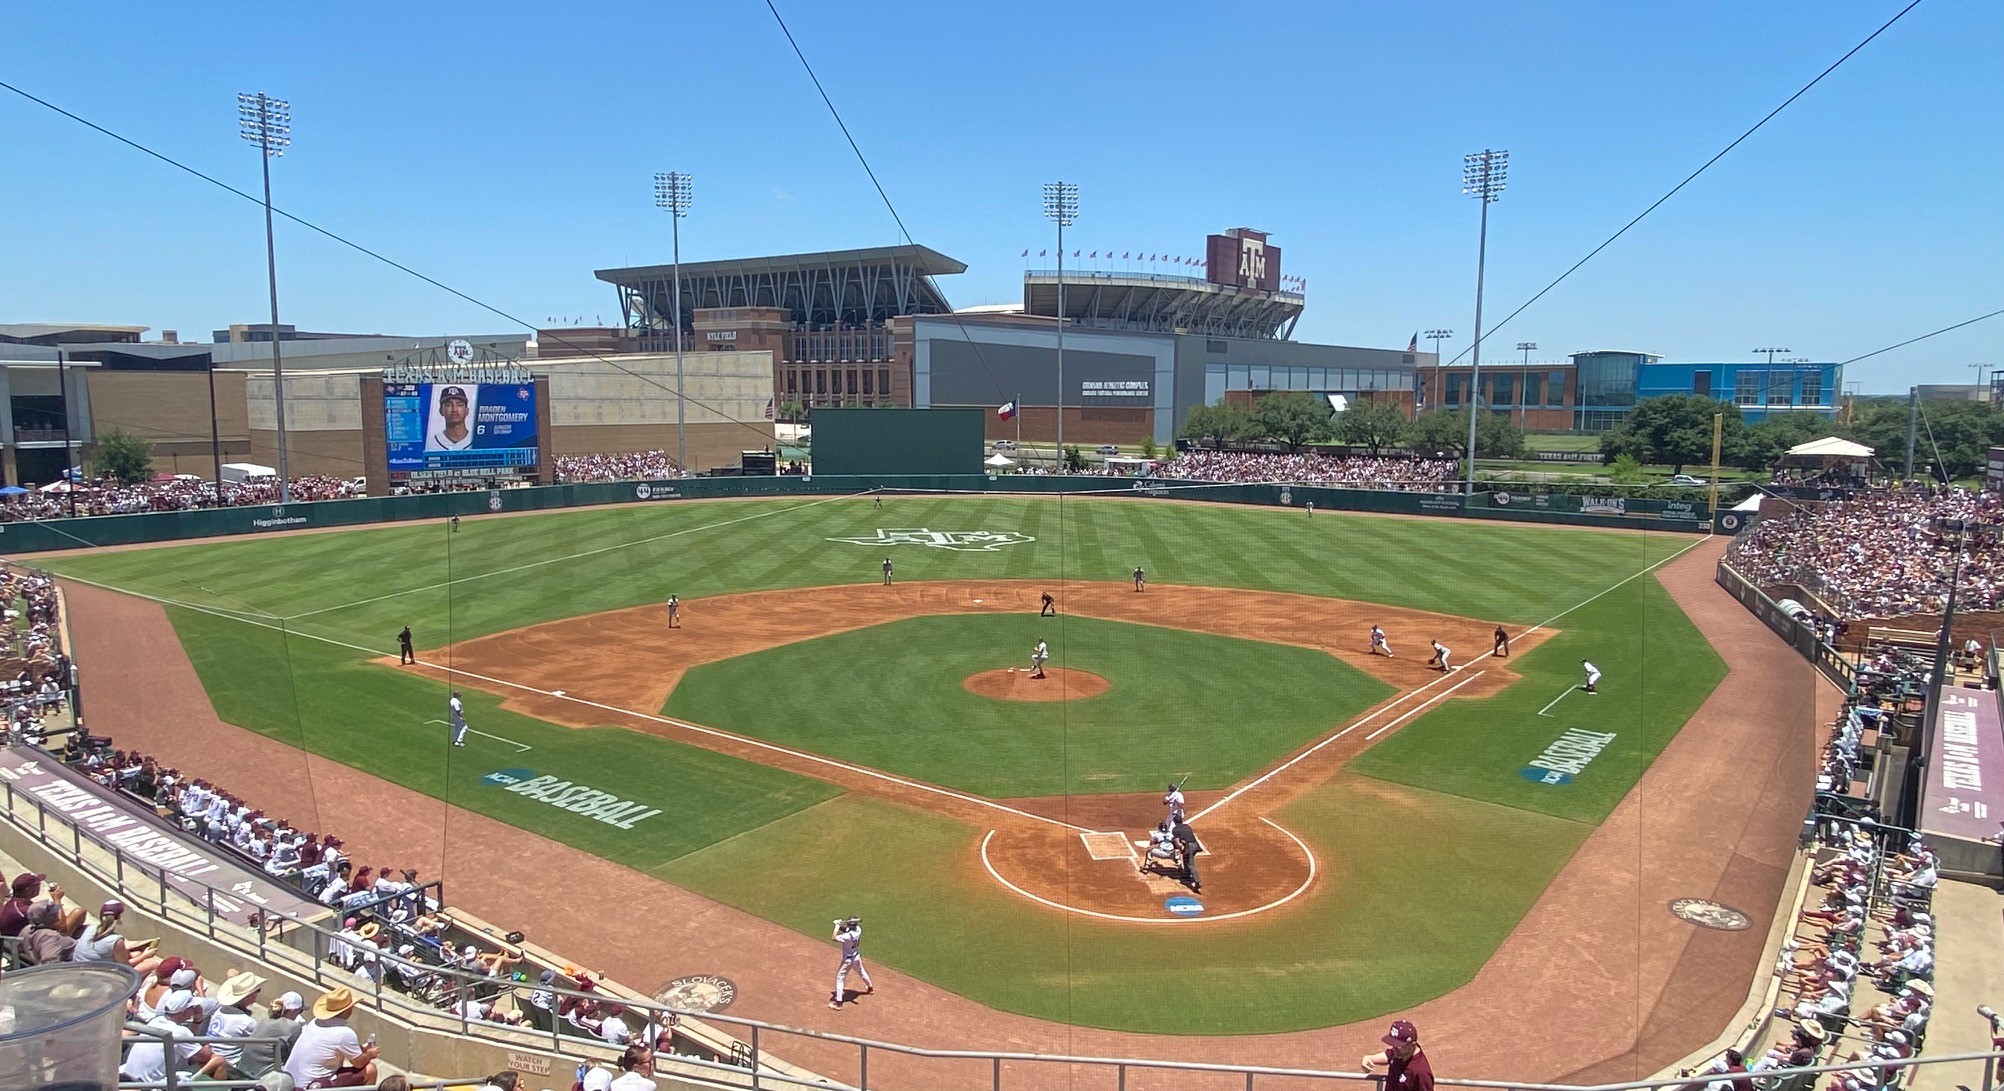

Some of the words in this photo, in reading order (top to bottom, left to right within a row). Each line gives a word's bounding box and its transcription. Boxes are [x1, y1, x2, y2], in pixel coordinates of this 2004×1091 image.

[706, 332, 721, 341] KYLE
[721, 331, 737, 340] FIELD
[382, 367, 433, 384] TEXAS
[437, 367, 464, 384] A&M
[469, 368, 535, 385] BASEBALL
[478, 405, 507, 413] BRADEN
[477, 412, 529, 423] MONTGOMERY
[476, 424, 486, 435] 6
[1539, 452, 1562, 460] TEXAS
[410, 470, 433, 480] OLSEN
[462, 468, 480, 478] BLUE
[480, 466, 497, 476] BELL
[496, 466, 515, 476] PARK
[253, 516, 307, 528] Higginbotham
[1528, 727, 1618, 775] BASEBALL
[504, 775, 663, 830] BASEBALL
[29, 779, 102, 812] TEXAS
[106, 825, 220, 882] BASEBALL
[515, 1054, 543, 1065] WATCH
[508, 1060, 530, 1071] YOUR
[531, 1064, 551, 1074] STEP
